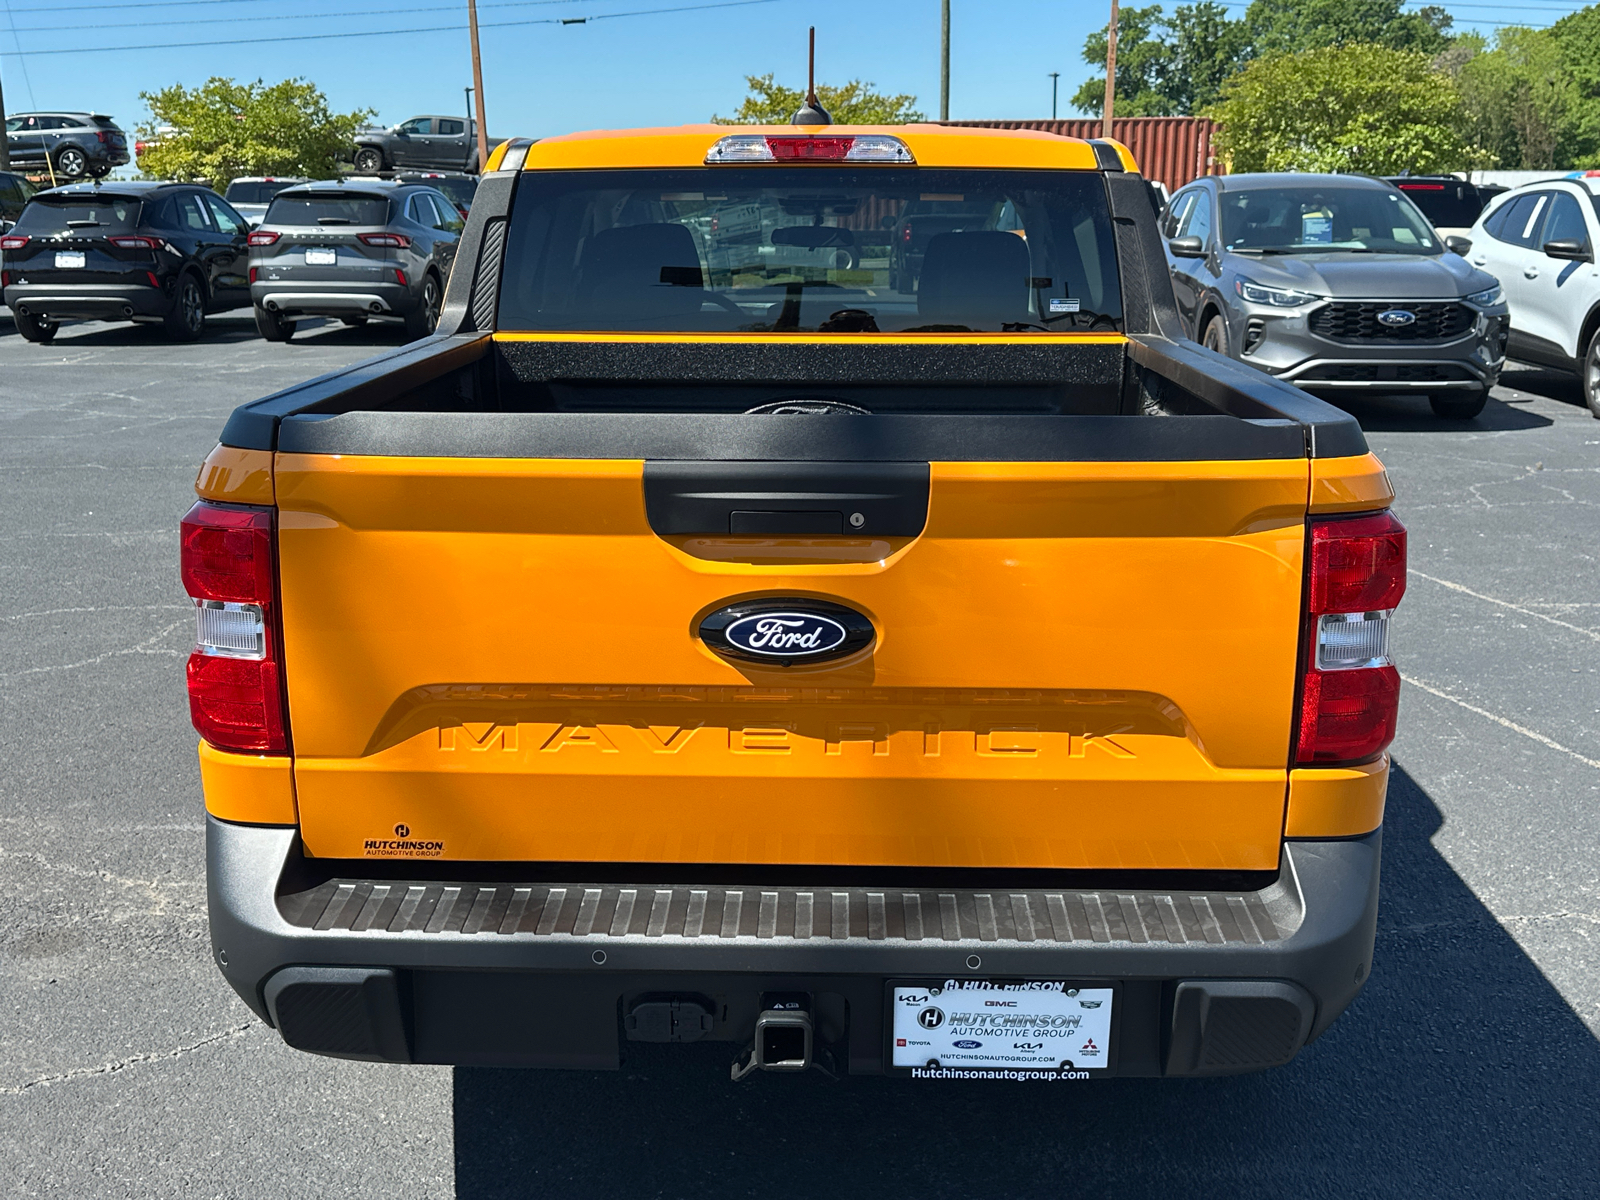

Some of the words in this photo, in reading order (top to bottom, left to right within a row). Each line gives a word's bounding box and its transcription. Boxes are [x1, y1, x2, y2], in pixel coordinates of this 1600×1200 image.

[748, 618, 823, 648] Ford
[437, 715, 1137, 759] MAVERICK
[396, 824, 409, 838] H
[364, 840, 443, 850] HUTCHINSON
[948, 1012, 1082, 1029] HUTCHINSON
[950, 1028, 1030, 1037] AUTOMOTIVE
[1032, 1029, 1075, 1038] GROUP
[940, 1053, 1056, 1062] HUTCHINSONAUTOGROUP.COM
[911, 1067, 1090, 1081] Hutchinsonautogroup.com
